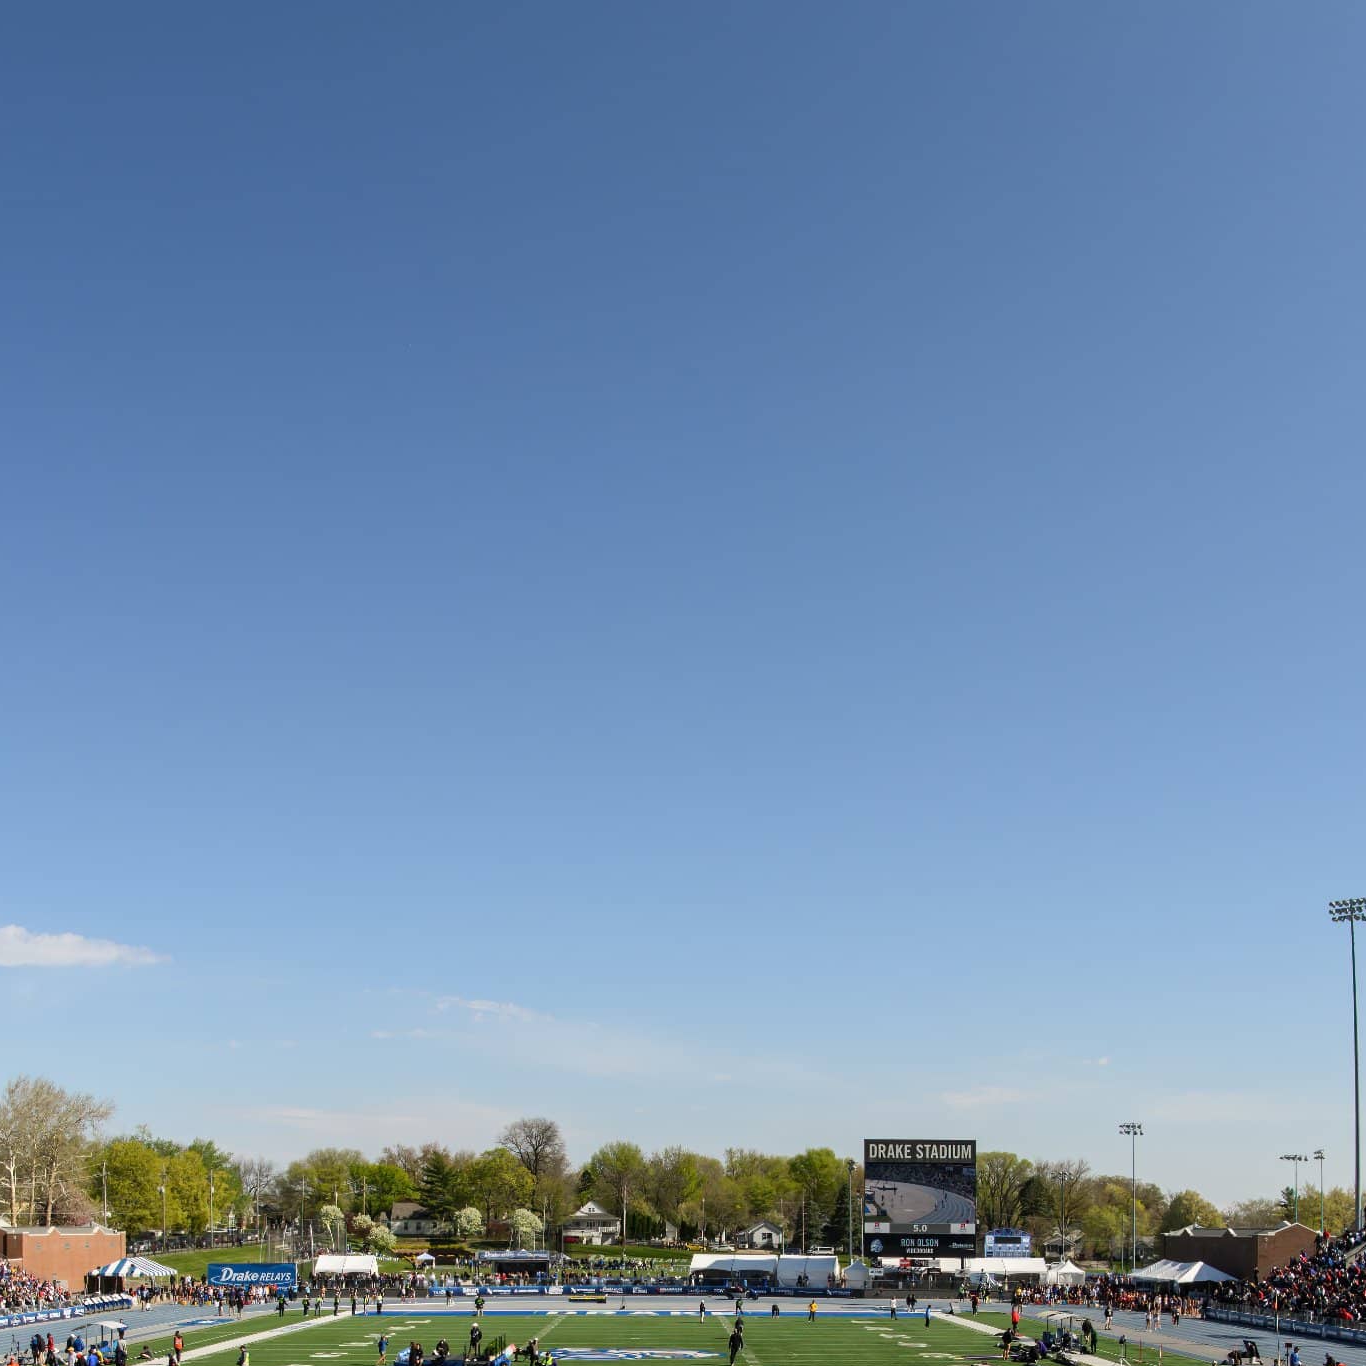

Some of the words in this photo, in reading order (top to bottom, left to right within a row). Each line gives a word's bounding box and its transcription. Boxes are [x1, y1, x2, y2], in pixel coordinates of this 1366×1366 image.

[869, 1143, 912, 1159] DRAKE
[916, 1144, 972, 1159] STADIUM
[220, 1267, 259, 1281] Drake
[259, 1272, 291, 1281] RELAYS
